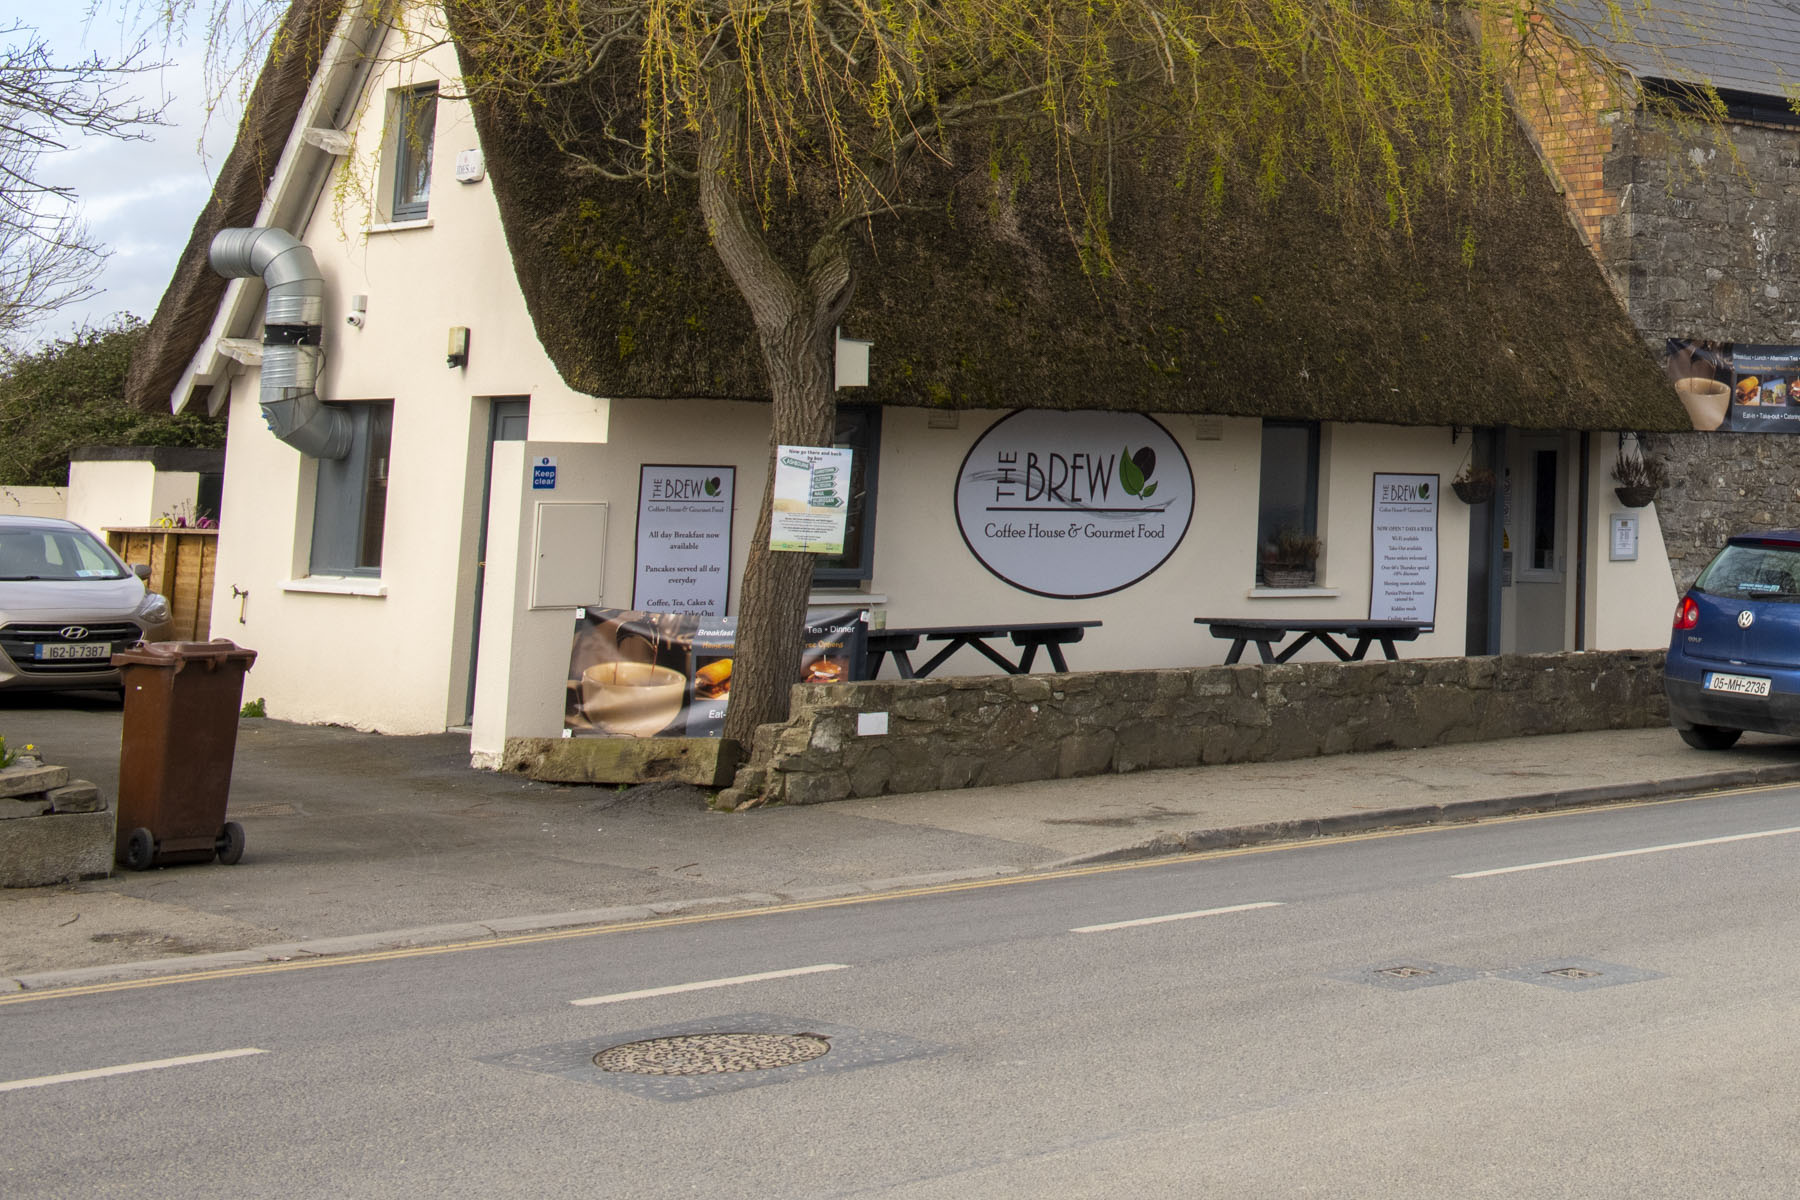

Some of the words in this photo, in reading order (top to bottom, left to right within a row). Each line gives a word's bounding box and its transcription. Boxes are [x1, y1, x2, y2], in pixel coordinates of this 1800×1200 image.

[535, 470, 555, 478] Keep
[995, 450, 1017, 502] THE
[1025, 452, 1115, 503] BREW
[652, 478, 663, 498] THE
[664, 479, 704, 499] BREW
[1391, 484, 1418, 502] BREW
[648, 531, 659, 539] All
[660, 531, 672, 540] day
[674, 531, 704, 539] Breakfast
[984, 523, 1026, 539] Coffee
[1028, 524, 1066, 539] House
[1067, 523, 1083, 538] &
[1084, 524, 1135, 539] Gourmet
[1137, 524, 1165, 539] Food
[670, 542, 699, 550] available
[709, 565, 720, 574] day
[668, 577, 697, 585] everyday
[647, 599, 670, 607] Coffee,
[672, 599, 685, 607] Tea,
[698, 629, 734, 637] Breakfast
[808, 625, 823, 634] Tea
[830, 625, 856, 633] Dinner
[49, 646, 104, 658] 162-D-7387
[1713, 677, 1766, 694] 05-MH-2736
